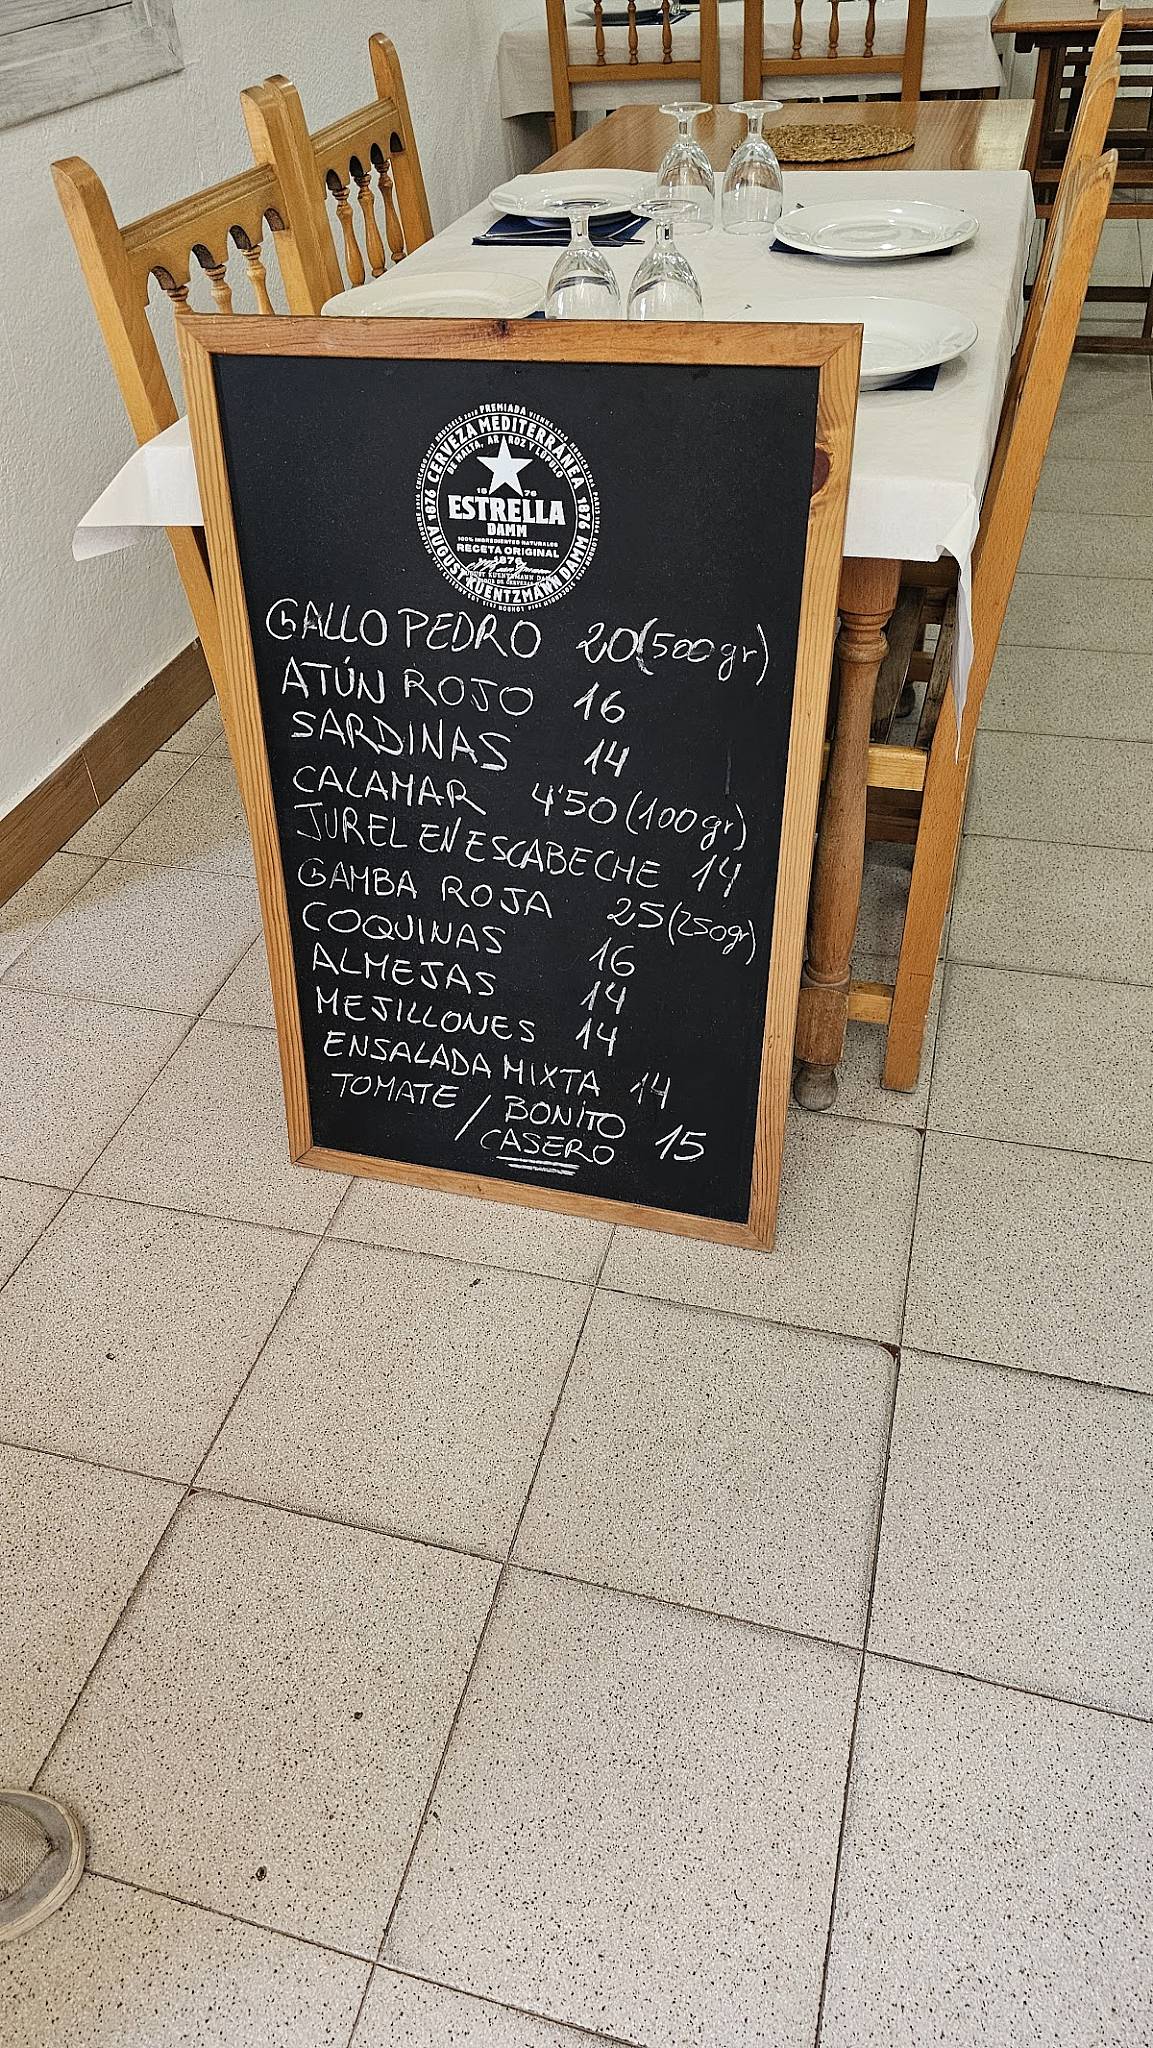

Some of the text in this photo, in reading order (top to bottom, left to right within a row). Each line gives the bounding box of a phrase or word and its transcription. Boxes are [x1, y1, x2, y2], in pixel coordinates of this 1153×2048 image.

[480, 403, 526, 416] PREMIADA
[424, 416, 590, 530] 1876 CERVEZA MEDITERRÁNEA 1876
[446, 461, 458, 475] DE
[528, 442, 535, 452] Y
[534, 446, 564, 478] LÚPULO
[448, 494, 566, 526] ESTRELLA
[486, 522, 528, 538] DAMM
[426, 526, 590, 603] AUGUST KUENTZMANN DAMM
[456, 544, 560, 558] RECETA ORIGINAL
[265, 597, 388, 647] GALLO
[397, 604, 542, 659] PEDRO
[281, 655, 626, 724] ATÚN ROJO 16
[290, 707, 630, 778] SARDINAS 14
[292, 765, 487, 816] CALAMAR
[293, 801, 742, 898] JUREL EN ESCABECHE 14
[297, 857, 418, 900] GAMBA
[441, 875, 553, 919] ROJA
[302, 901, 636, 977] COQUINAS 16
[312, 941, 627, 1015] ALMEJAS 14
[316, 985, 618, 1057] MEJILLONES 14
[323, 1029, 671, 1110] ENSALADA MIXTA 14
[331, 1072, 460, 1109] TOMATE
[504, 1095, 626, 1140] BONITO
[654, 1124, 707, 1161] 15
[479, 1127, 616, 1166] CASERO
